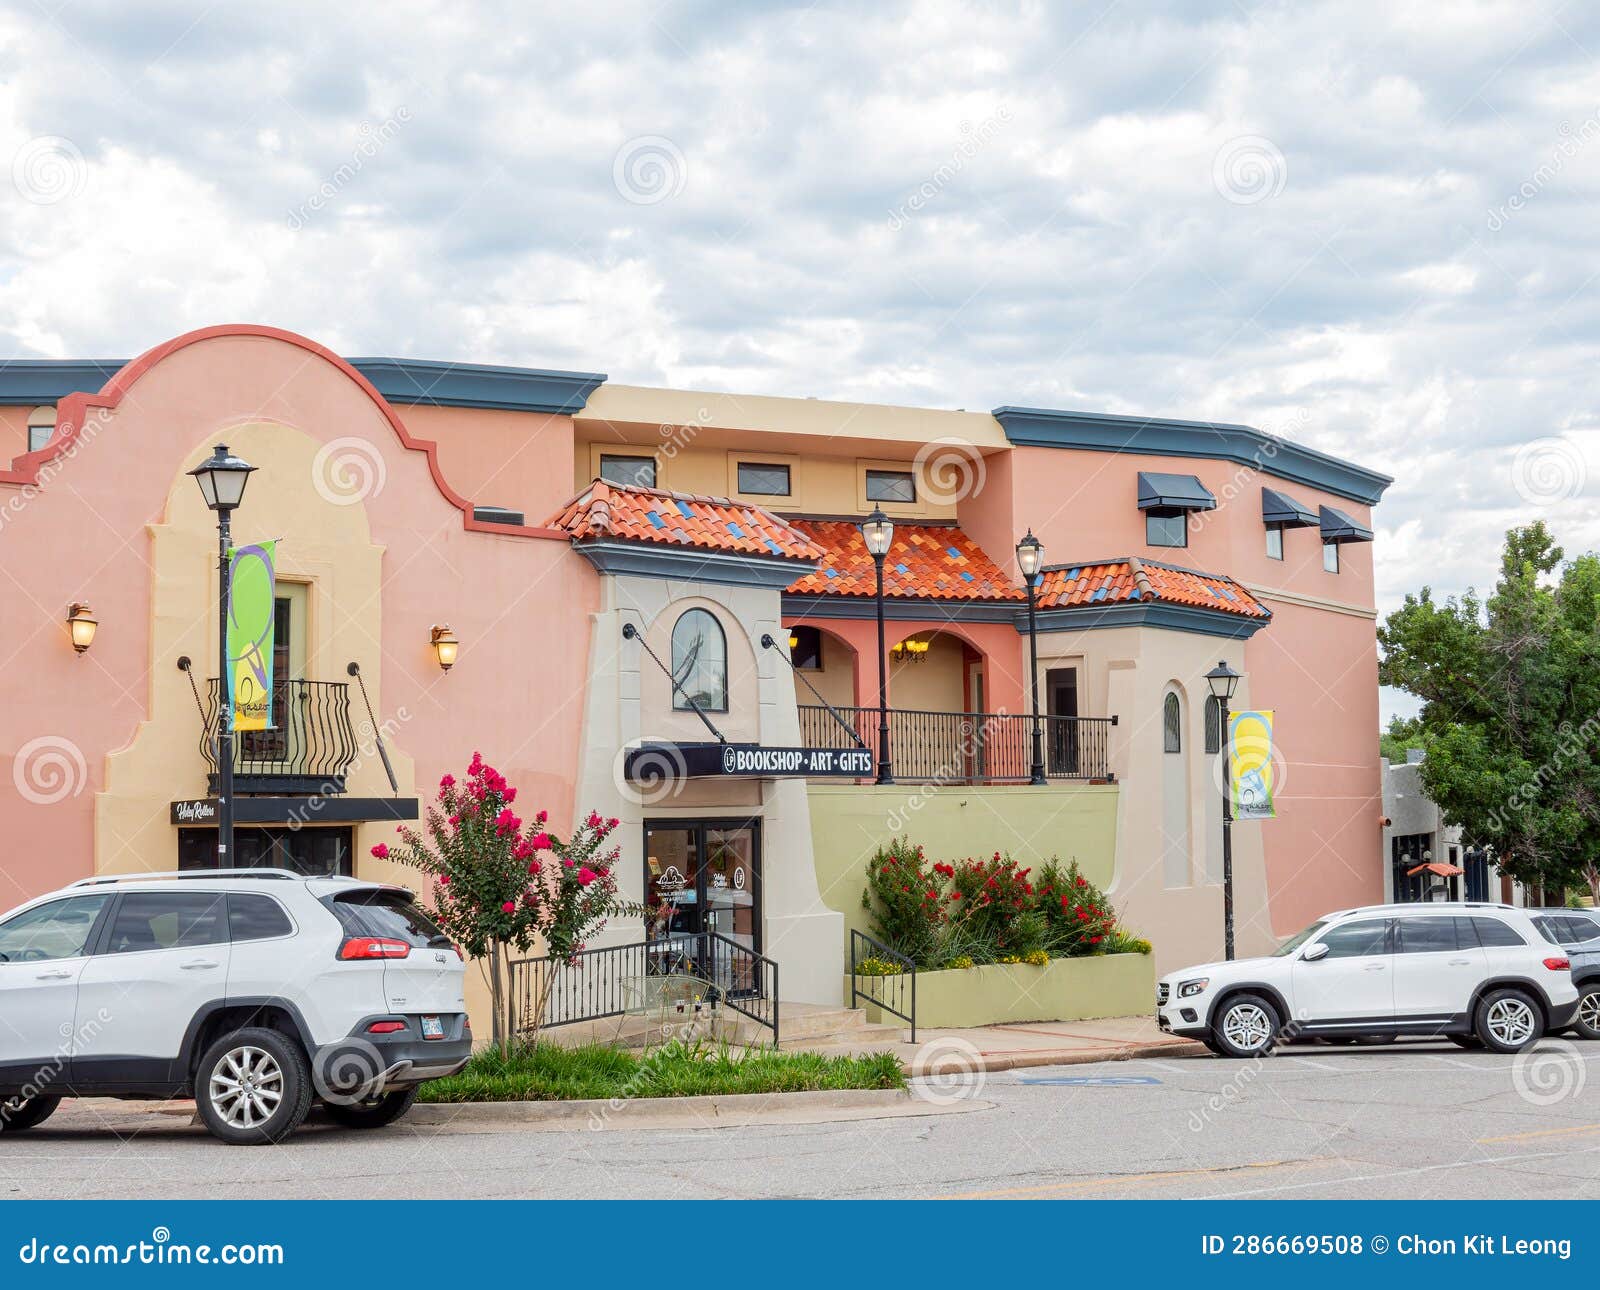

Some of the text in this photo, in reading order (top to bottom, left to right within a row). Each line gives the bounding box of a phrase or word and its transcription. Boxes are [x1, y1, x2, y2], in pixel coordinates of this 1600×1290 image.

[737, 750, 803, 771] BOOKSHOP
[809, 751, 833, 771] ART
[839, 752, 872, 772] GIFTS
